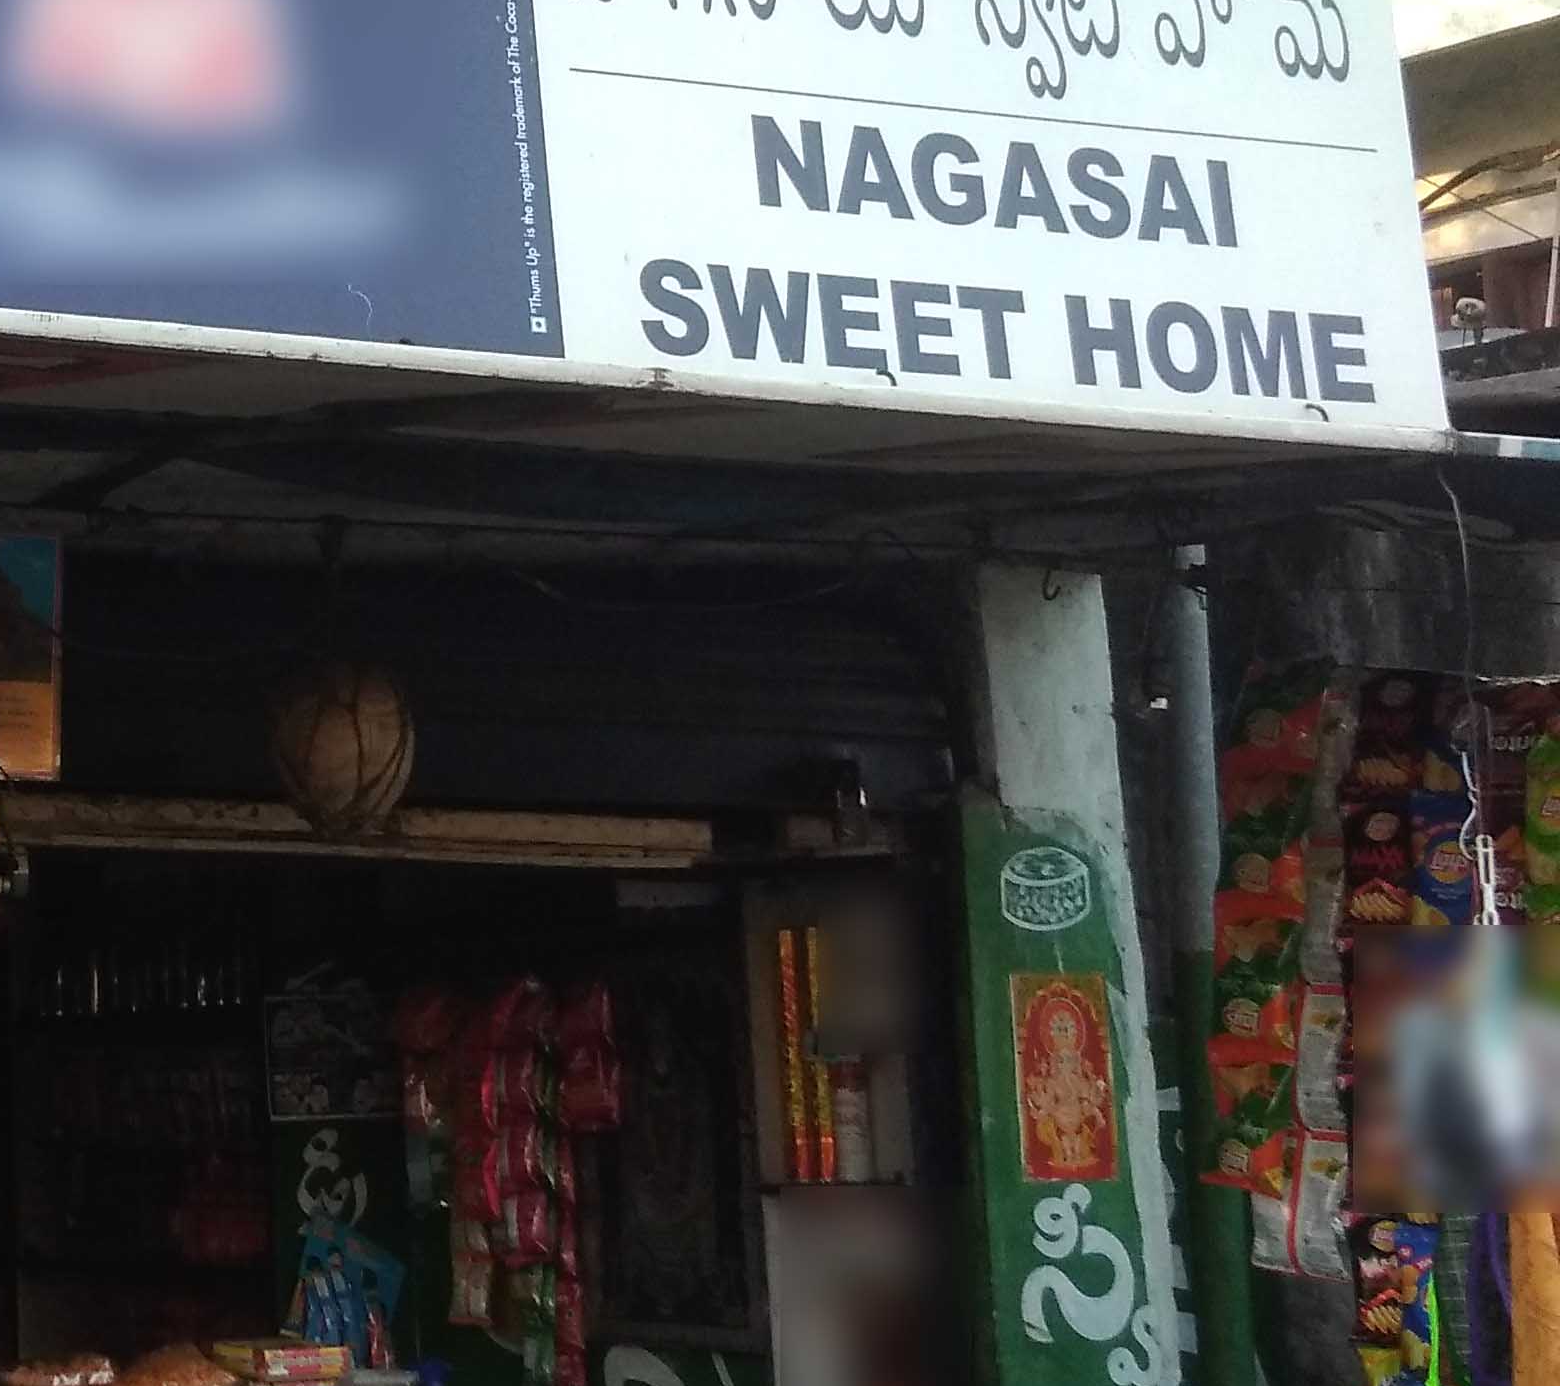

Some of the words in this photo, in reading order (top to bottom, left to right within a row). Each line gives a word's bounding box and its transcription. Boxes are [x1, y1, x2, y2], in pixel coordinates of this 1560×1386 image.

[507, 36, 520, 59] The
[507, 60, 520, 75] of
[509, 77, 528, 139] trademark
[515, 142, 534, 203] registered
[750, 114, 1238, 248] NAGASAI
[521, 205, 534, 225] the
[640, 259, 1025, 380] SWEET
[1062, 293, 1376, 403] HOME
